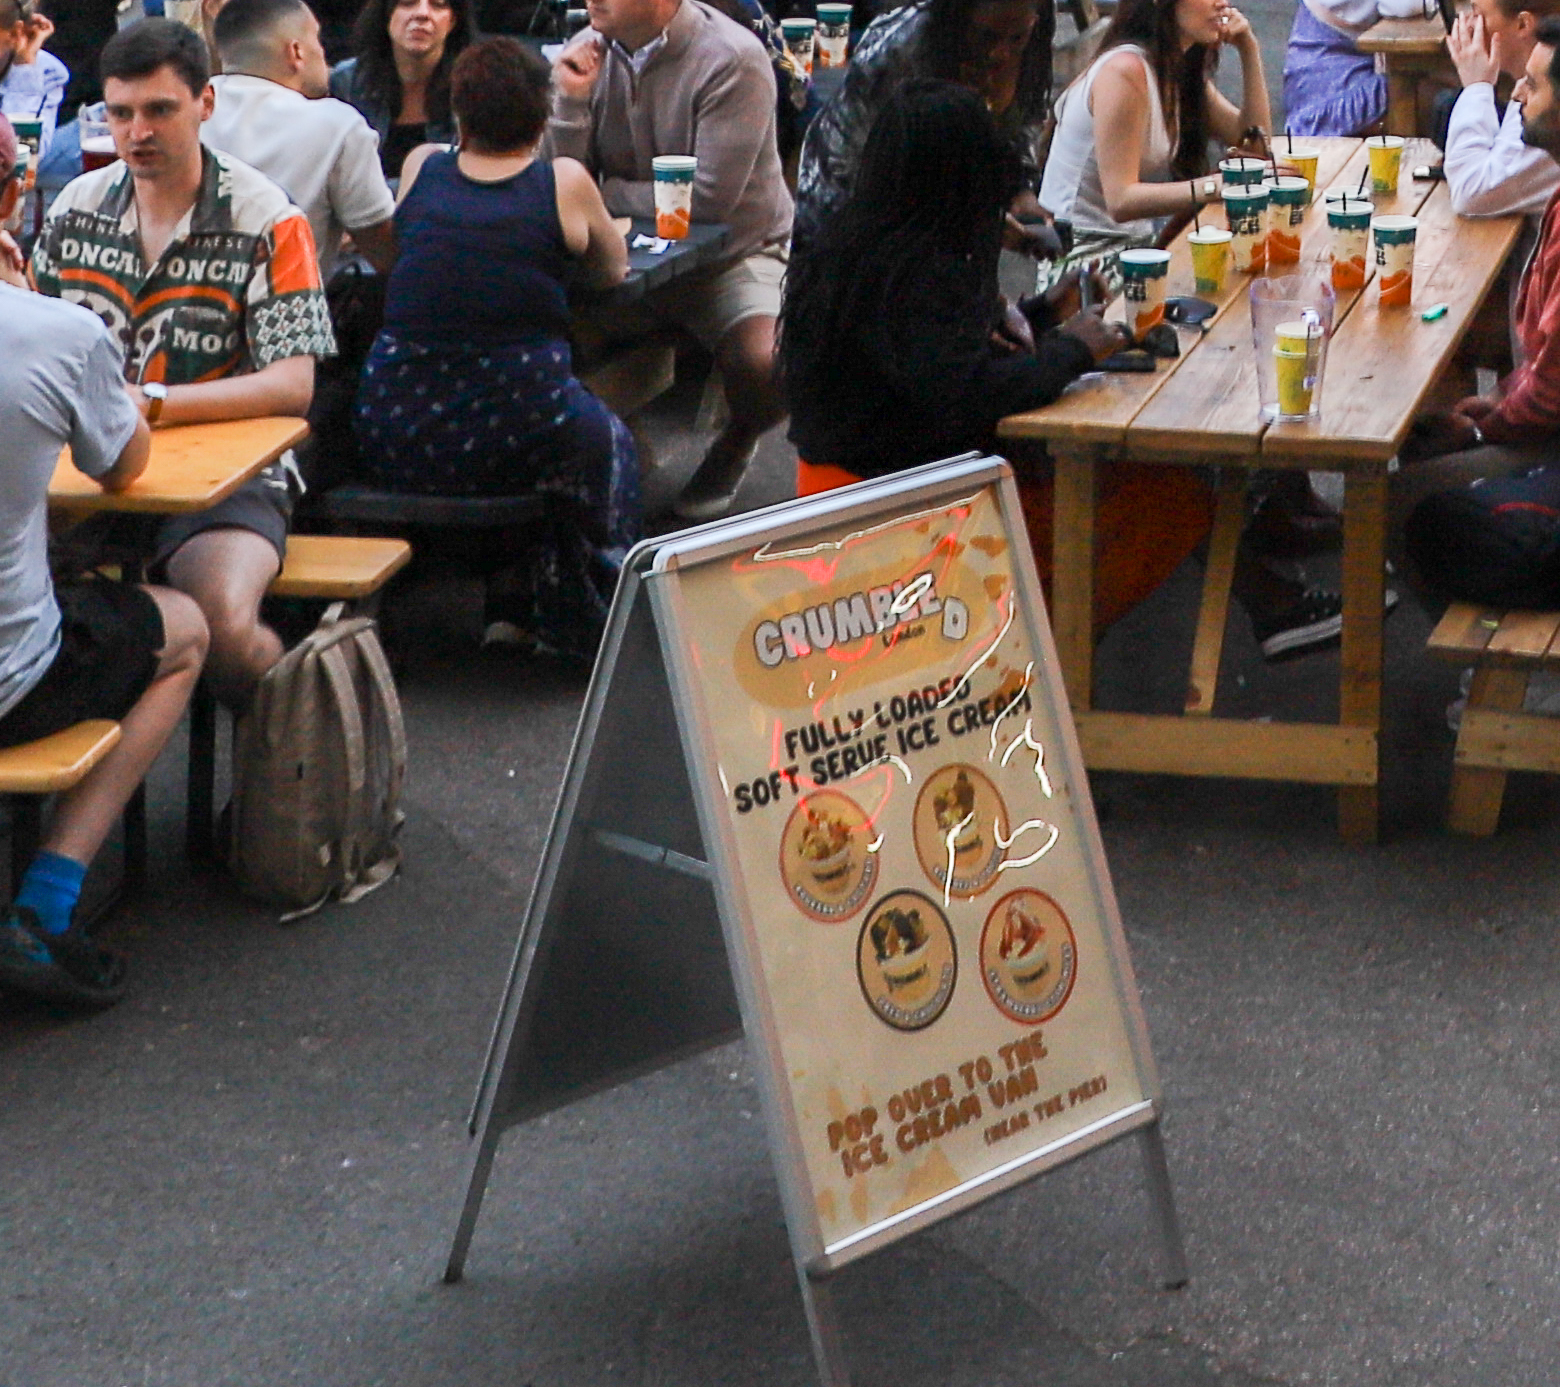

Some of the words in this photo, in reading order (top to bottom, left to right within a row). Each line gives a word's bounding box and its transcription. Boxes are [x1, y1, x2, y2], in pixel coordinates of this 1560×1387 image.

[733, 765, 801, 814] SOFT
[810, 733, 890, 785] SERVE
[896, 717, 940, 755] ICE
[946, 689, 1032, 737] CREAM
[784, 708, 865, 760] FULLY
[873, 674, 972, 727] LOADED
[827, 1106, 878, 1152] POP
[887, 1072, 954, 1123] OVER
[958, 1056, 993, 1090] TO
[998, 1029, 1048, 1072] THE
[841, 1132, 889, 1178] ICE
[895, 1092, 983, 1154] CREAM
[987, 1065, 1039, 1109] VAN
